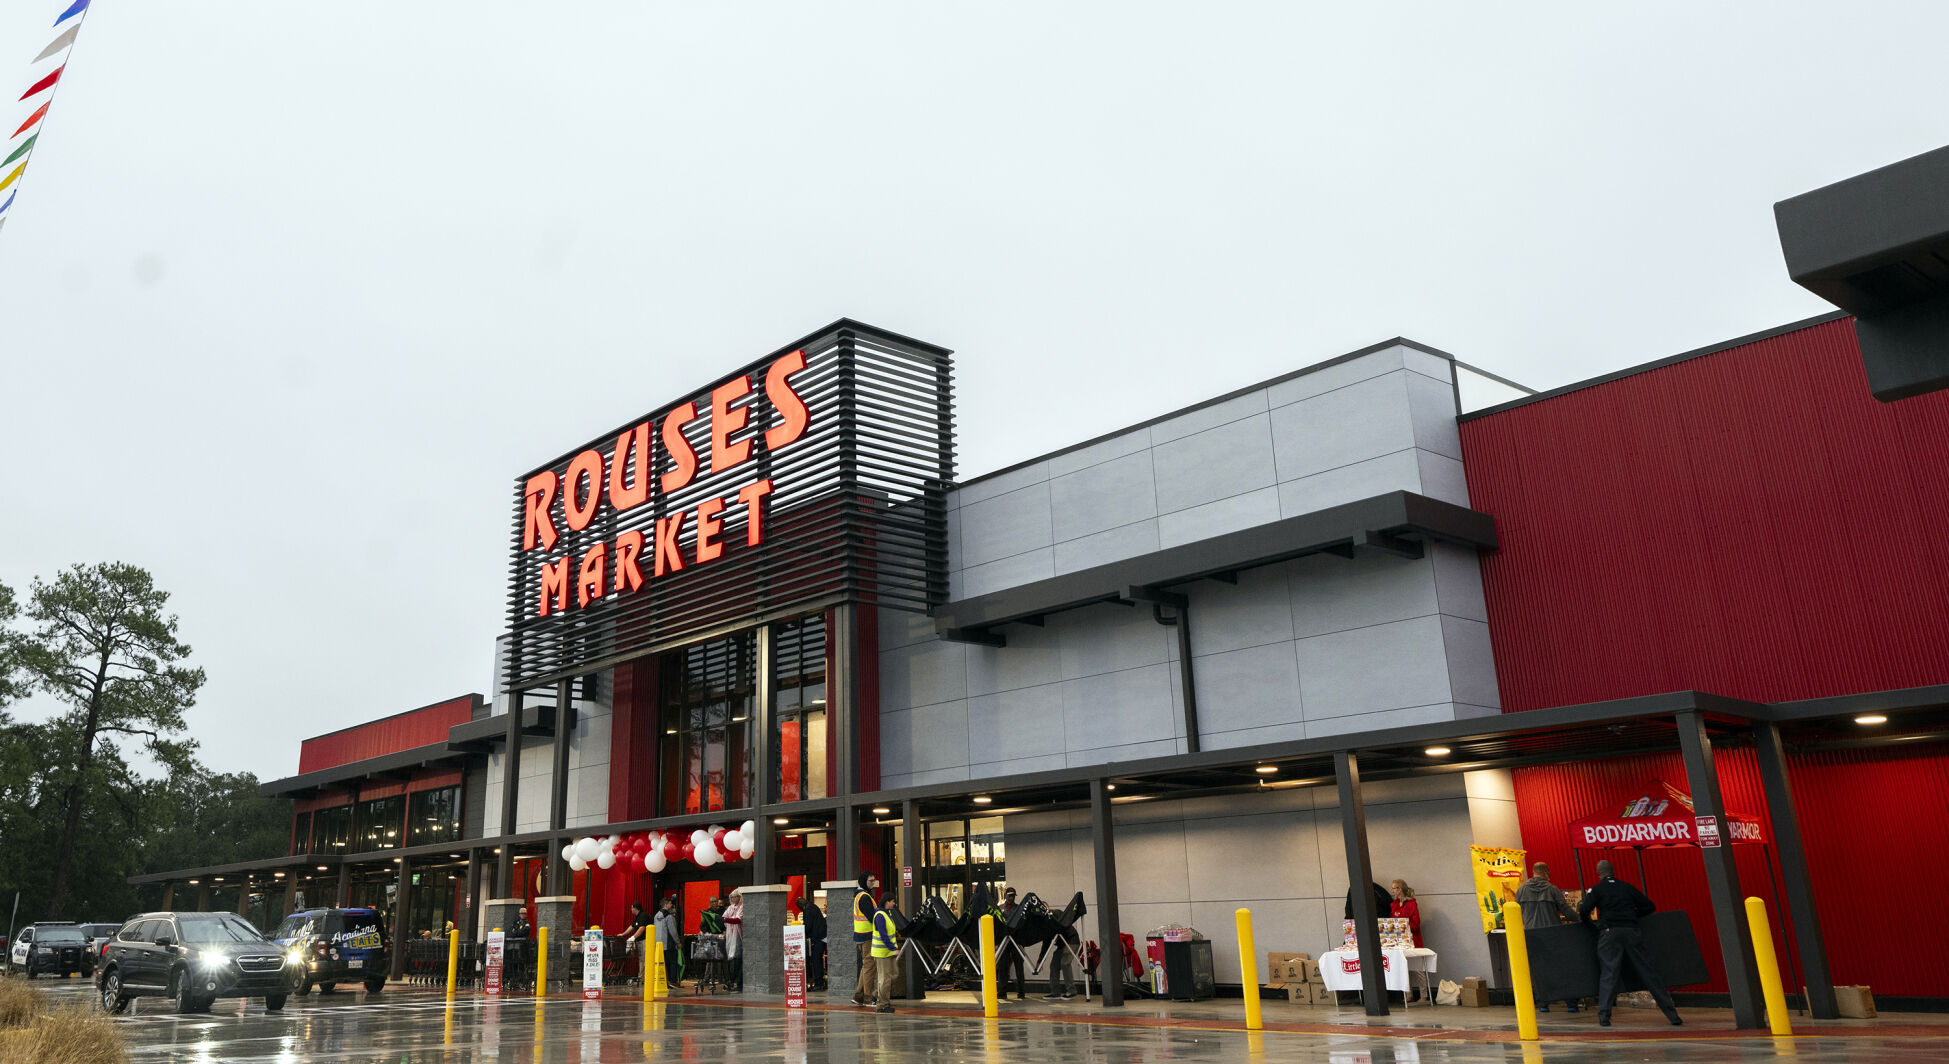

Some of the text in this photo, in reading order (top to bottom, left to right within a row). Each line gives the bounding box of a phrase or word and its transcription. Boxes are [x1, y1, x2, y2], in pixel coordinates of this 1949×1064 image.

[522, 348, 812, 553] ROUSES
[538, 478, 775, 618] MARKET
[1583, 821, 1691, 844] BODYARMOR
[1727, 821, 1762, 840] YARMOR
[331, 924, 378, 945] Acadiana
[350, 932, 381, 949] EATS
[1343, 961, 1360, 971] Little
